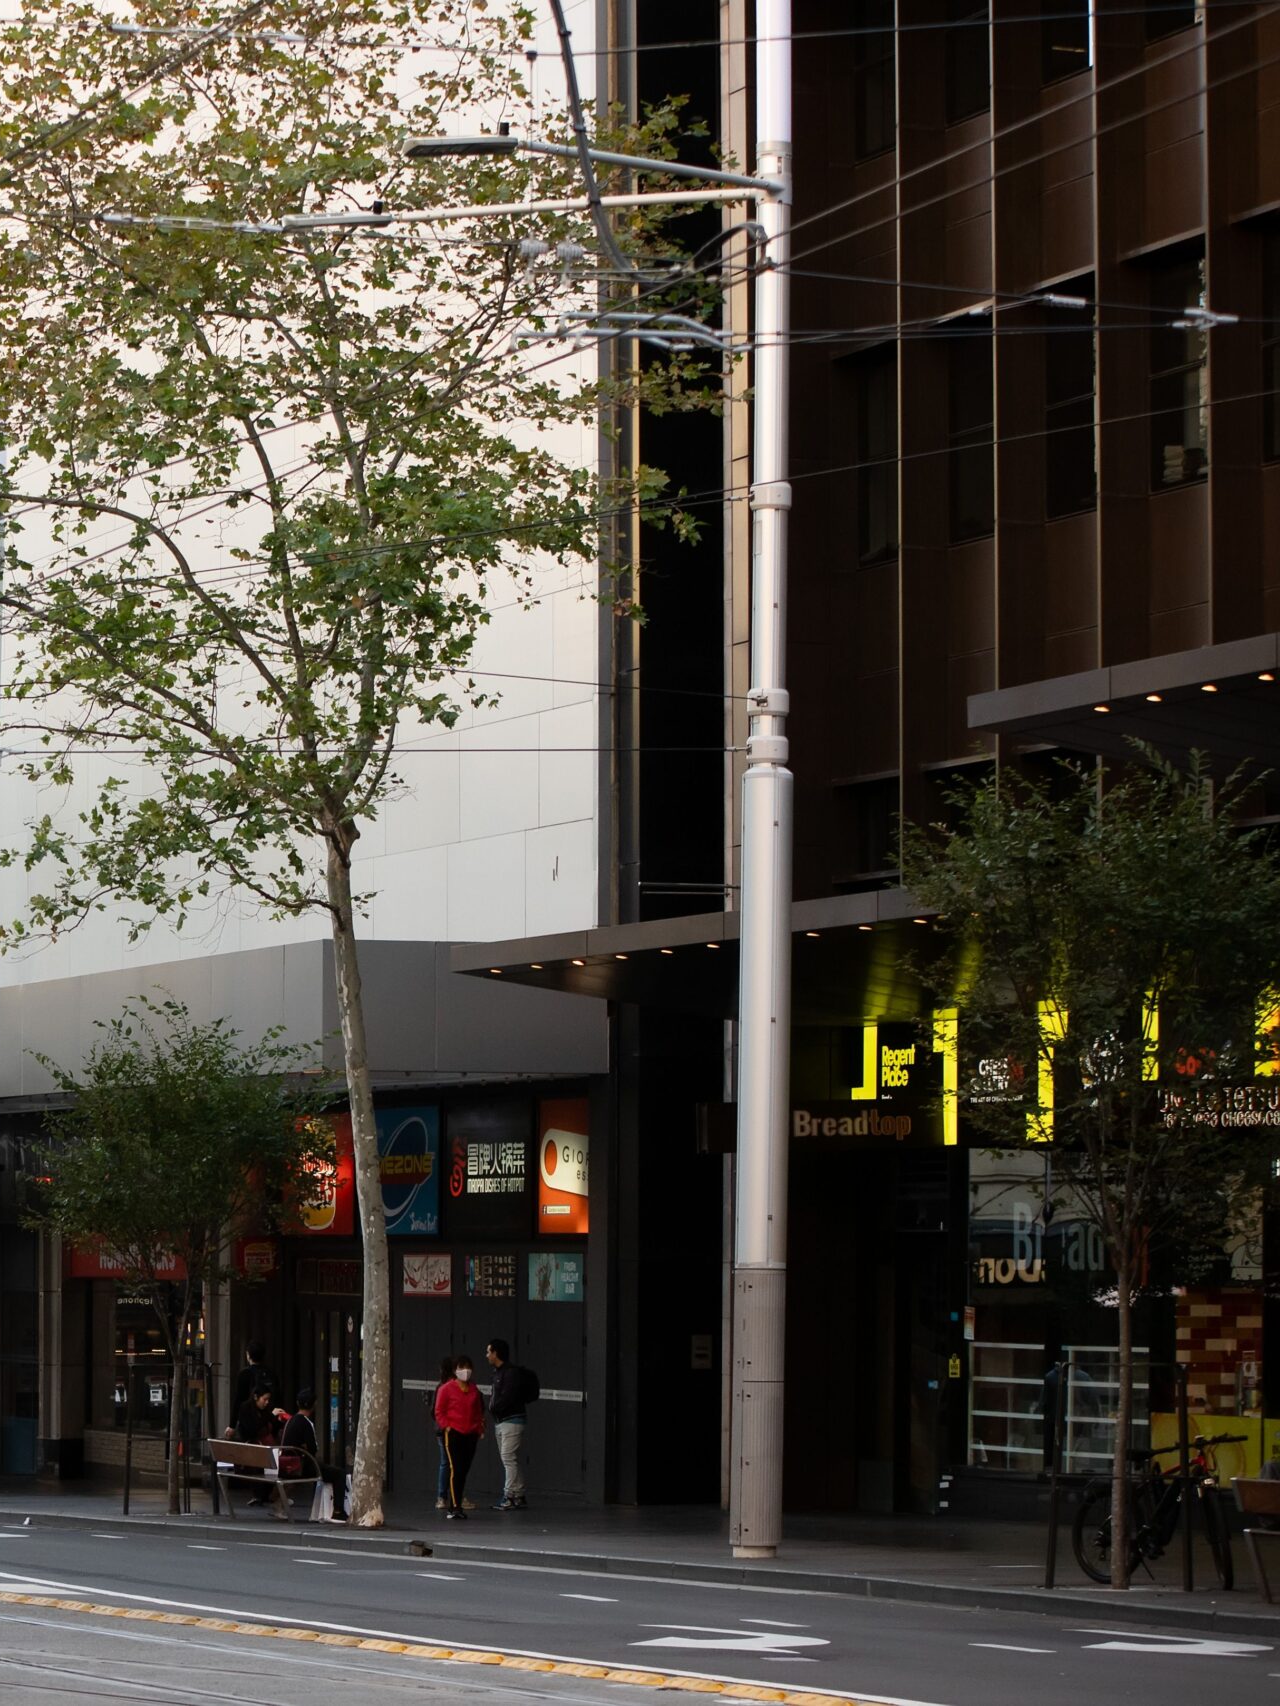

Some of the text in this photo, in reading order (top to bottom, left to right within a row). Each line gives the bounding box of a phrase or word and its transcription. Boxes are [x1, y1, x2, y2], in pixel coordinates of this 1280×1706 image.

[881, 1043, 915, 1069] Regent
[881, 1067, 909, 1087] Place
[792, 1108, 911, 1142] Breadtop
